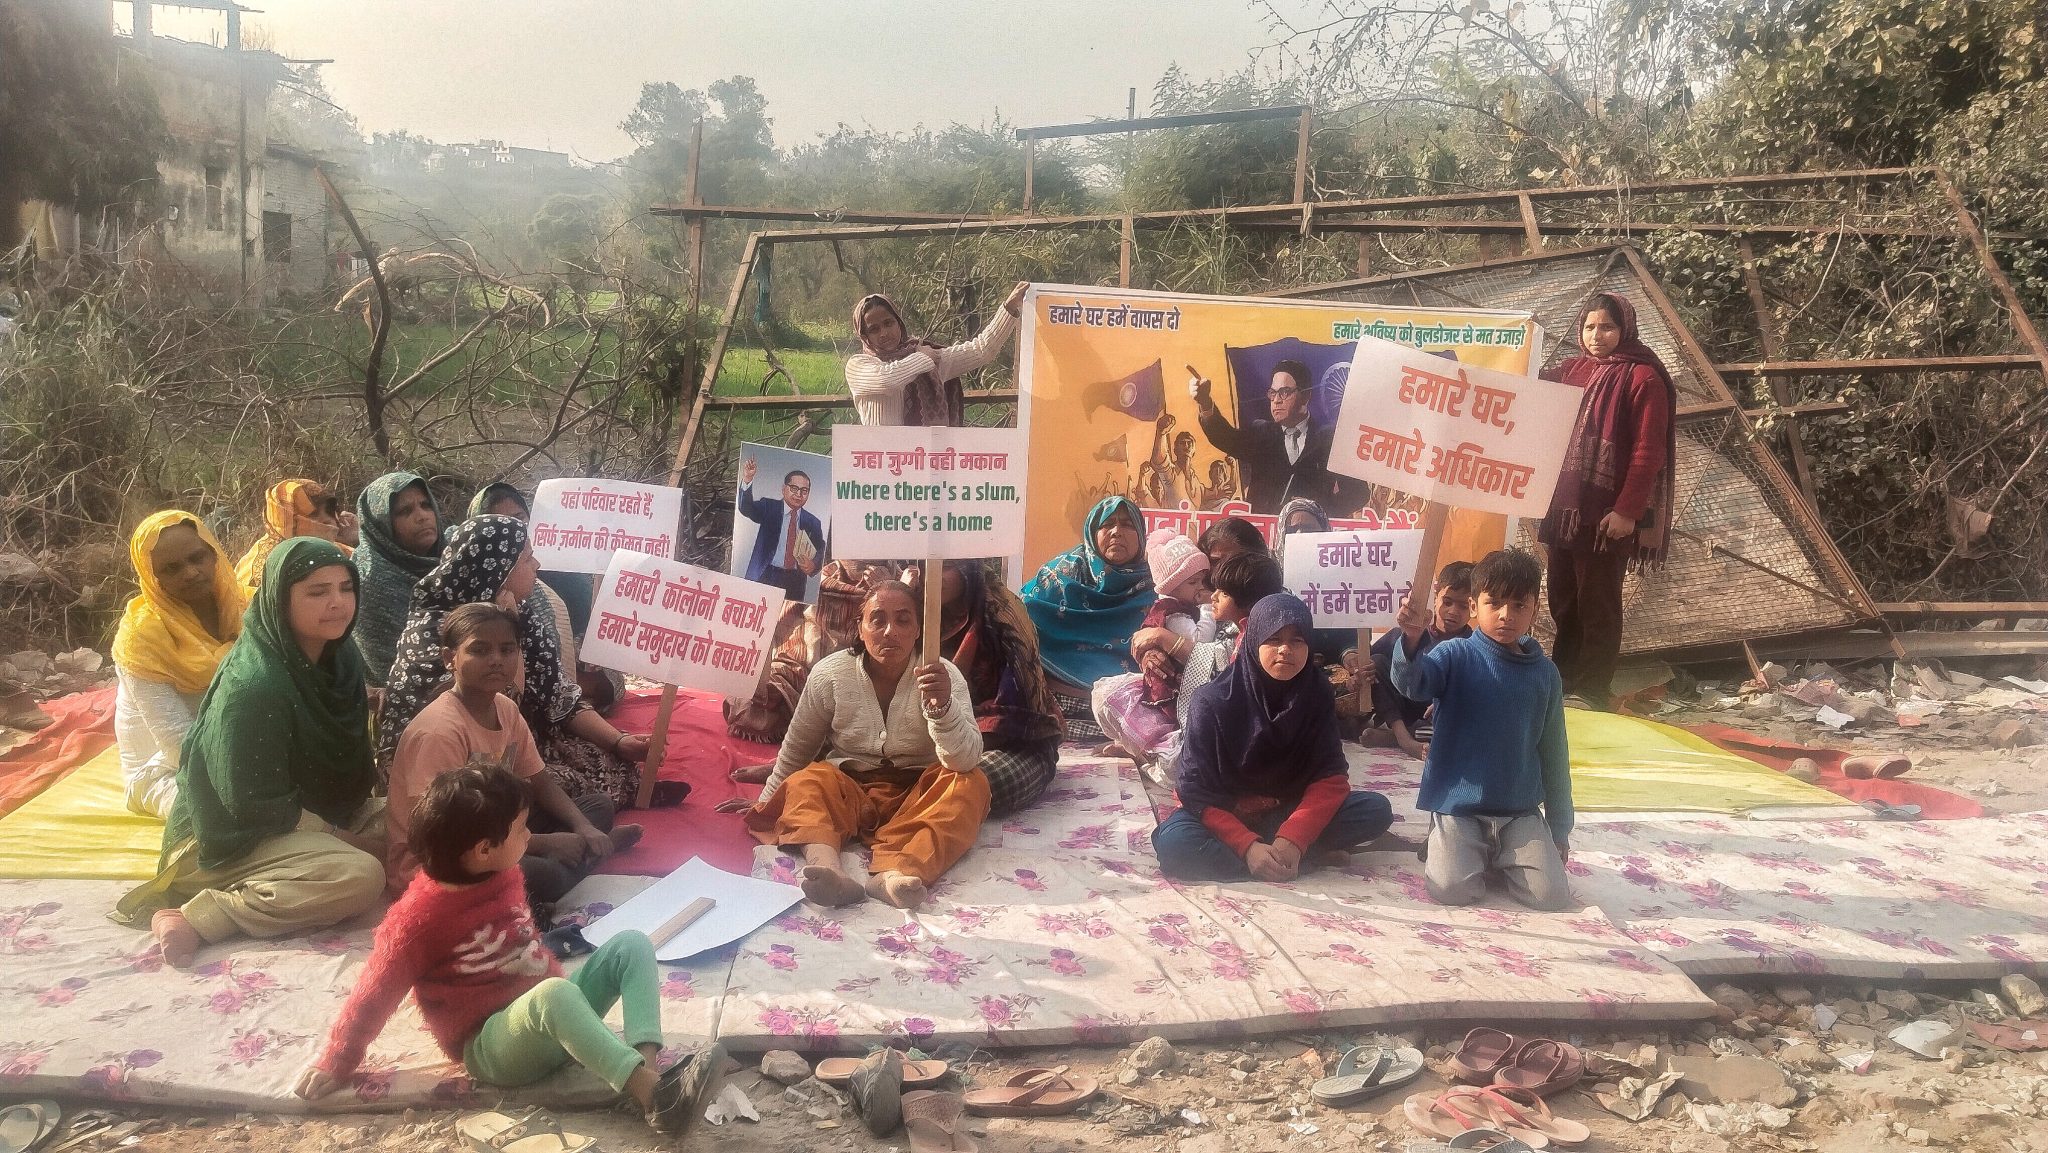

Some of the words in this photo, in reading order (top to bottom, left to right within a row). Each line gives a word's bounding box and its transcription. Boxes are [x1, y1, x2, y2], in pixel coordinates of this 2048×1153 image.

[1049, 301, 1083, 325] हमारे
[1085, 308, 1104, 326] घर
[1106, 304, 1130, 327] हमें
[1130, 309, 1164, 329] वापस
[1166, 306, 1180, 330] दो
[1334, 319, 1361, 340] हमारे
[1399, 321, 1413, 342] को
[1415, 323, 1462, 347] बुलडोजर
[1463, 323, 1474, 344] से
[1475, 328, 1494, 345] मत
[1494, 325, 1526, 350] उजाड़ो
[1398, 365, 1471, 418] हमारे
[1471, 385, 1517, 435] घर,
[851, 451, 884, 469] जहा
[886, 447, 926, 476] जुग्गी
[928, 447, 956, 470] वही
[959, 452, 1008, 471] मकान
[1357, 424, 1426, 475] हमारे
[1426, 442, 1535, 499] अधिकार
[561, 487, 581, 510] यहां
[581, 487, 618, 512] परिवार
[619, 491, 643, 515] रहते
[643, 493, 654, 520] हैं,
[836, 480, 890, 500] Where
[894, 481, 957, 501] there's
[961, 485, 971, 501] a
[976, 482, 1020, 504] slum,
[864, 511, 928, 532] there's
[932, 517, 942, 532] a
[947, 512, 993, 532] home
[594, 527, 610, 550] की
[611, 529, 644, 552] कीमत
[645, 533, 671, 558] नहीं!
[1317, 535, 1363, 568] हमारे
[1366, 541, 1398, 571] घर,
[615, 569, 661, 605] हमारी
[661, 575, 721, 621] कॉलोनी
[721, 596, 768, 638] बचाओ,
[1321, 582, 1353, 615] हमें
[1353, 581, 1394, 614] रहने
[597, 610, 639, 647] हमारे
[636, 621, 693, 664] समुदाय
[690, 629, 714, 666] को
[711, 640, 762, 676] बचाओ!
